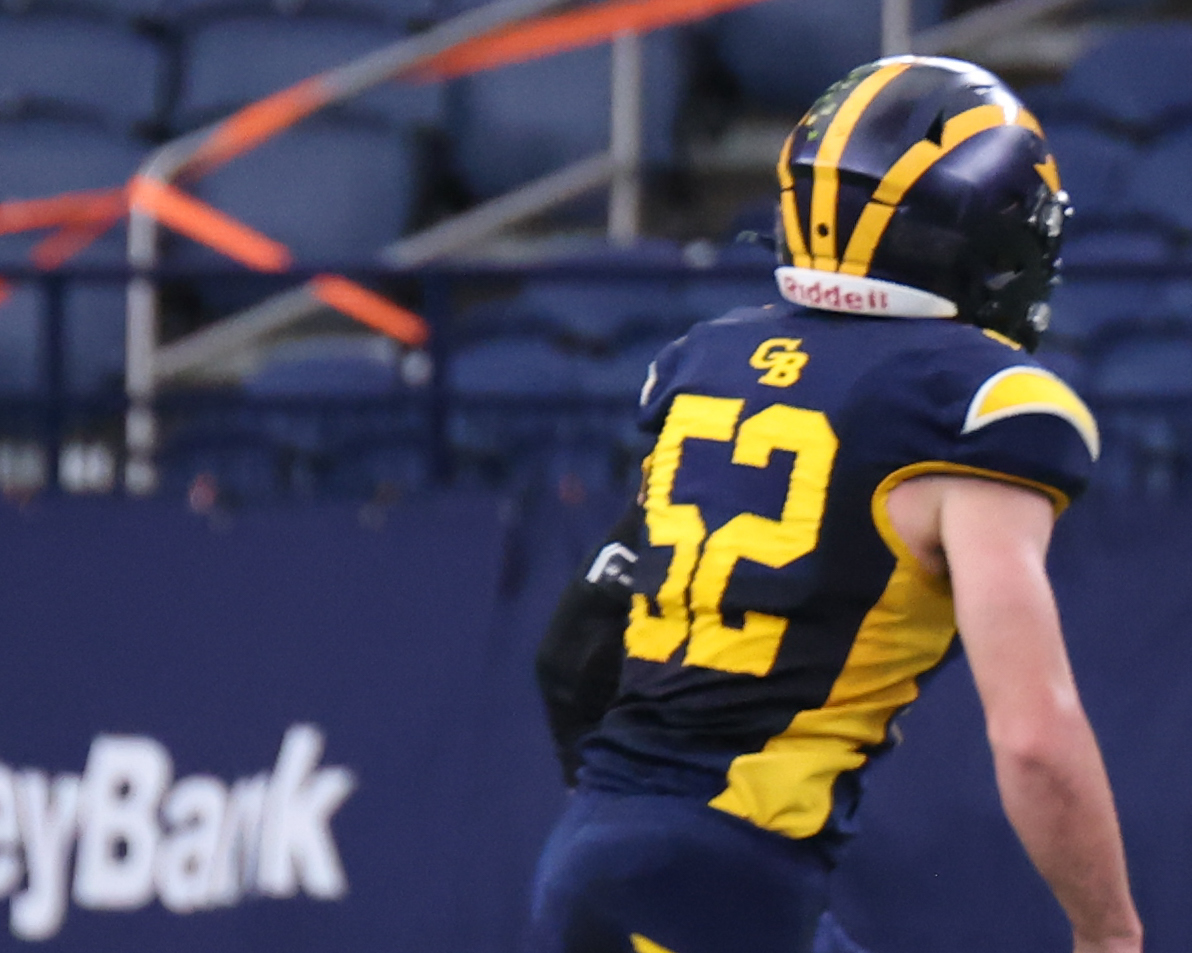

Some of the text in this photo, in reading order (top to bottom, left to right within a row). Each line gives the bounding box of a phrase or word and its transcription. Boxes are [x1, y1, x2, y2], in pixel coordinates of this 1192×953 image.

[784, 276, 888, 311] Riddell
[749, 337, 809, 388] GB
[624, 393, 839, 677] 52
